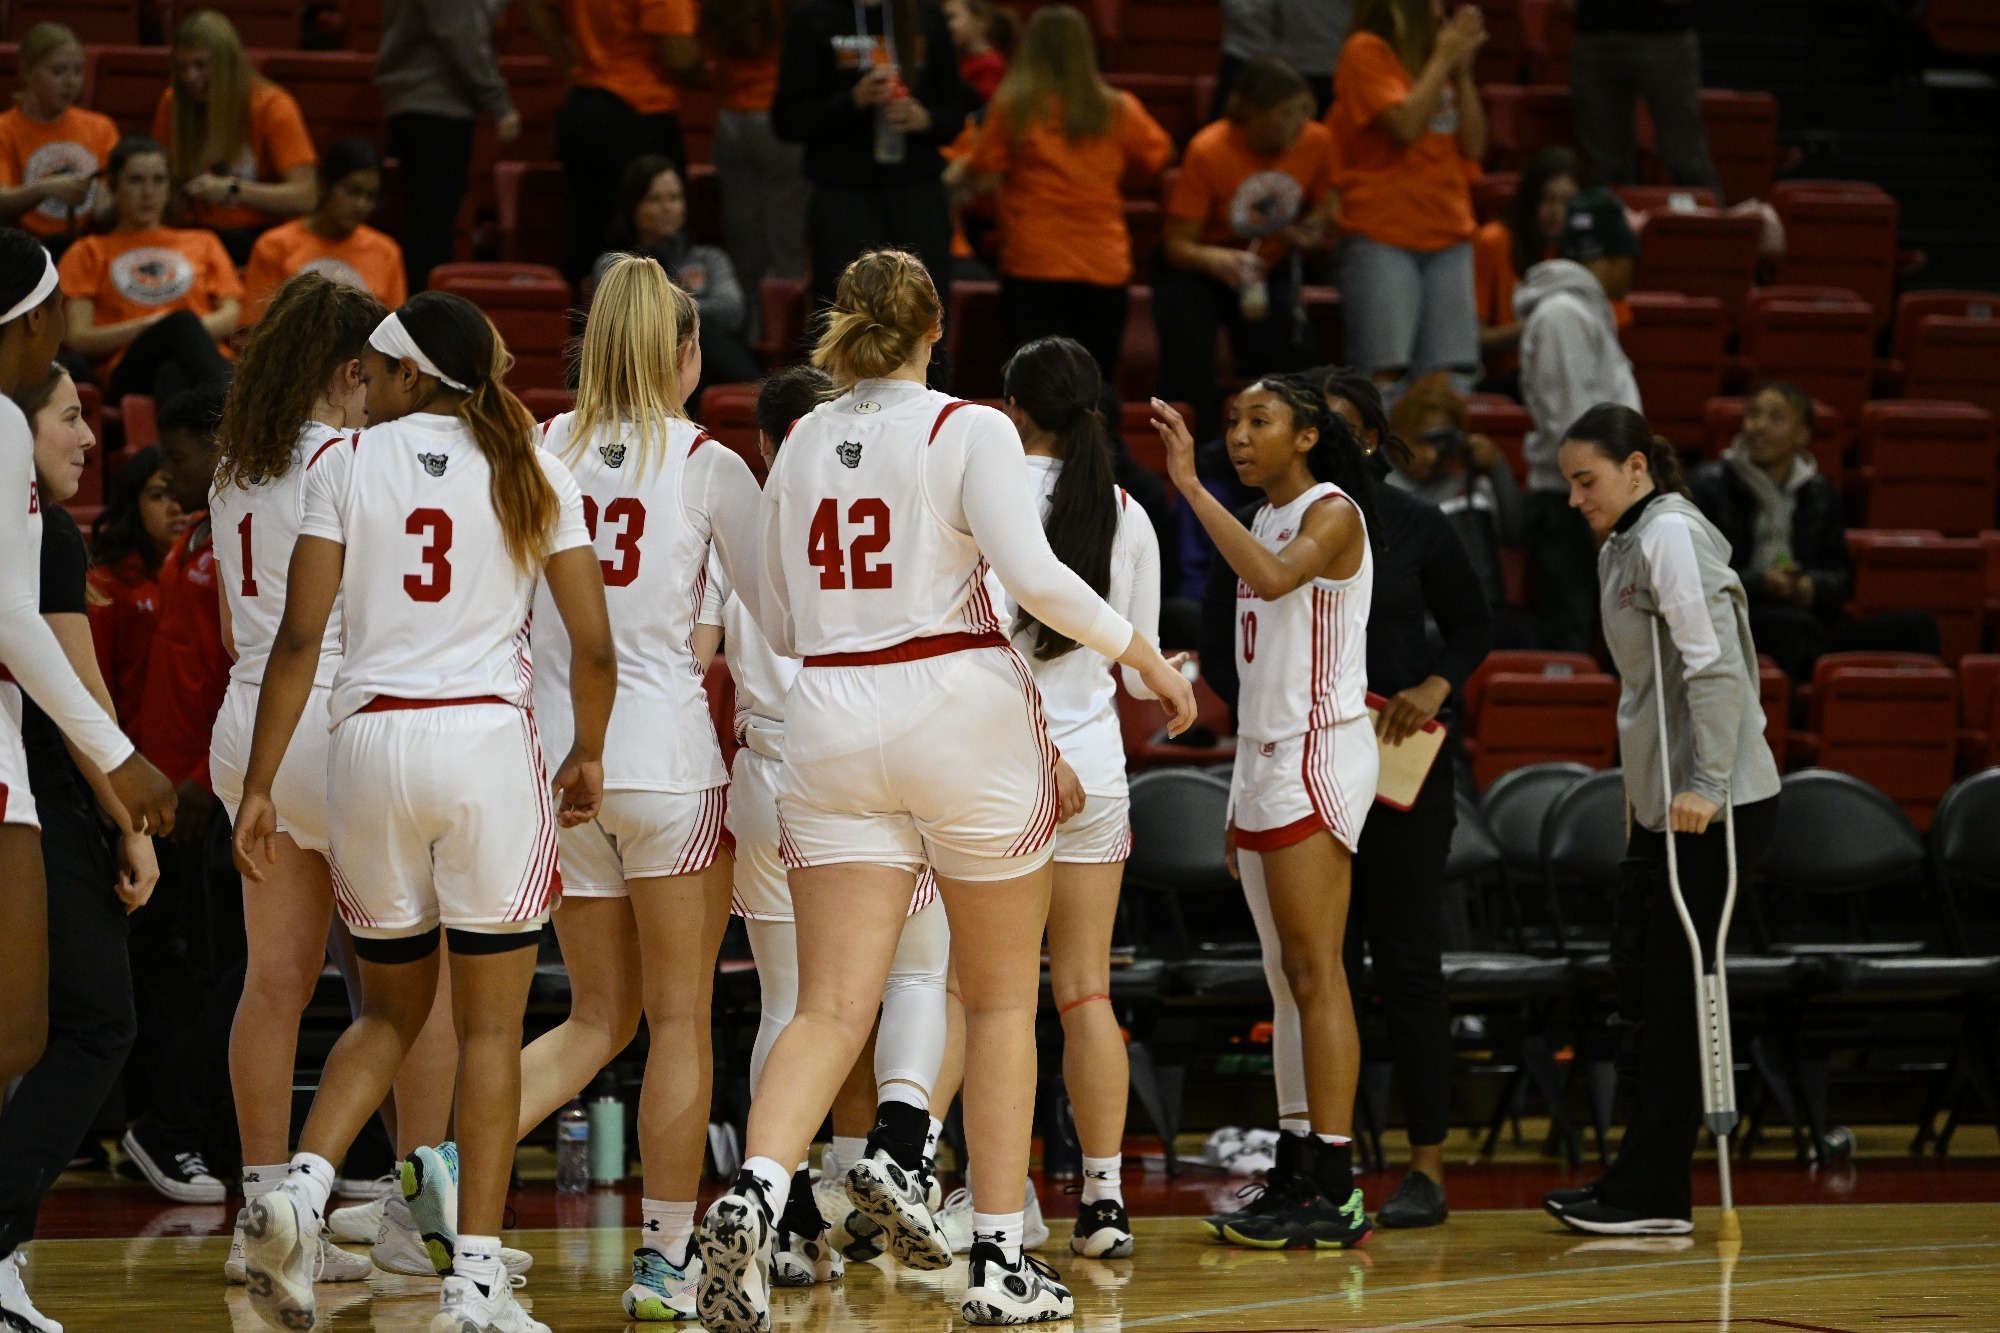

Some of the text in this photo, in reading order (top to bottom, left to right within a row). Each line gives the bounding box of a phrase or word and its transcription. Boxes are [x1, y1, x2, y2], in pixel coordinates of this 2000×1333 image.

[237, 512, 259, 597] 1
[403, 507, 453, 603] 3
[807, 497, 893, 590] 42
